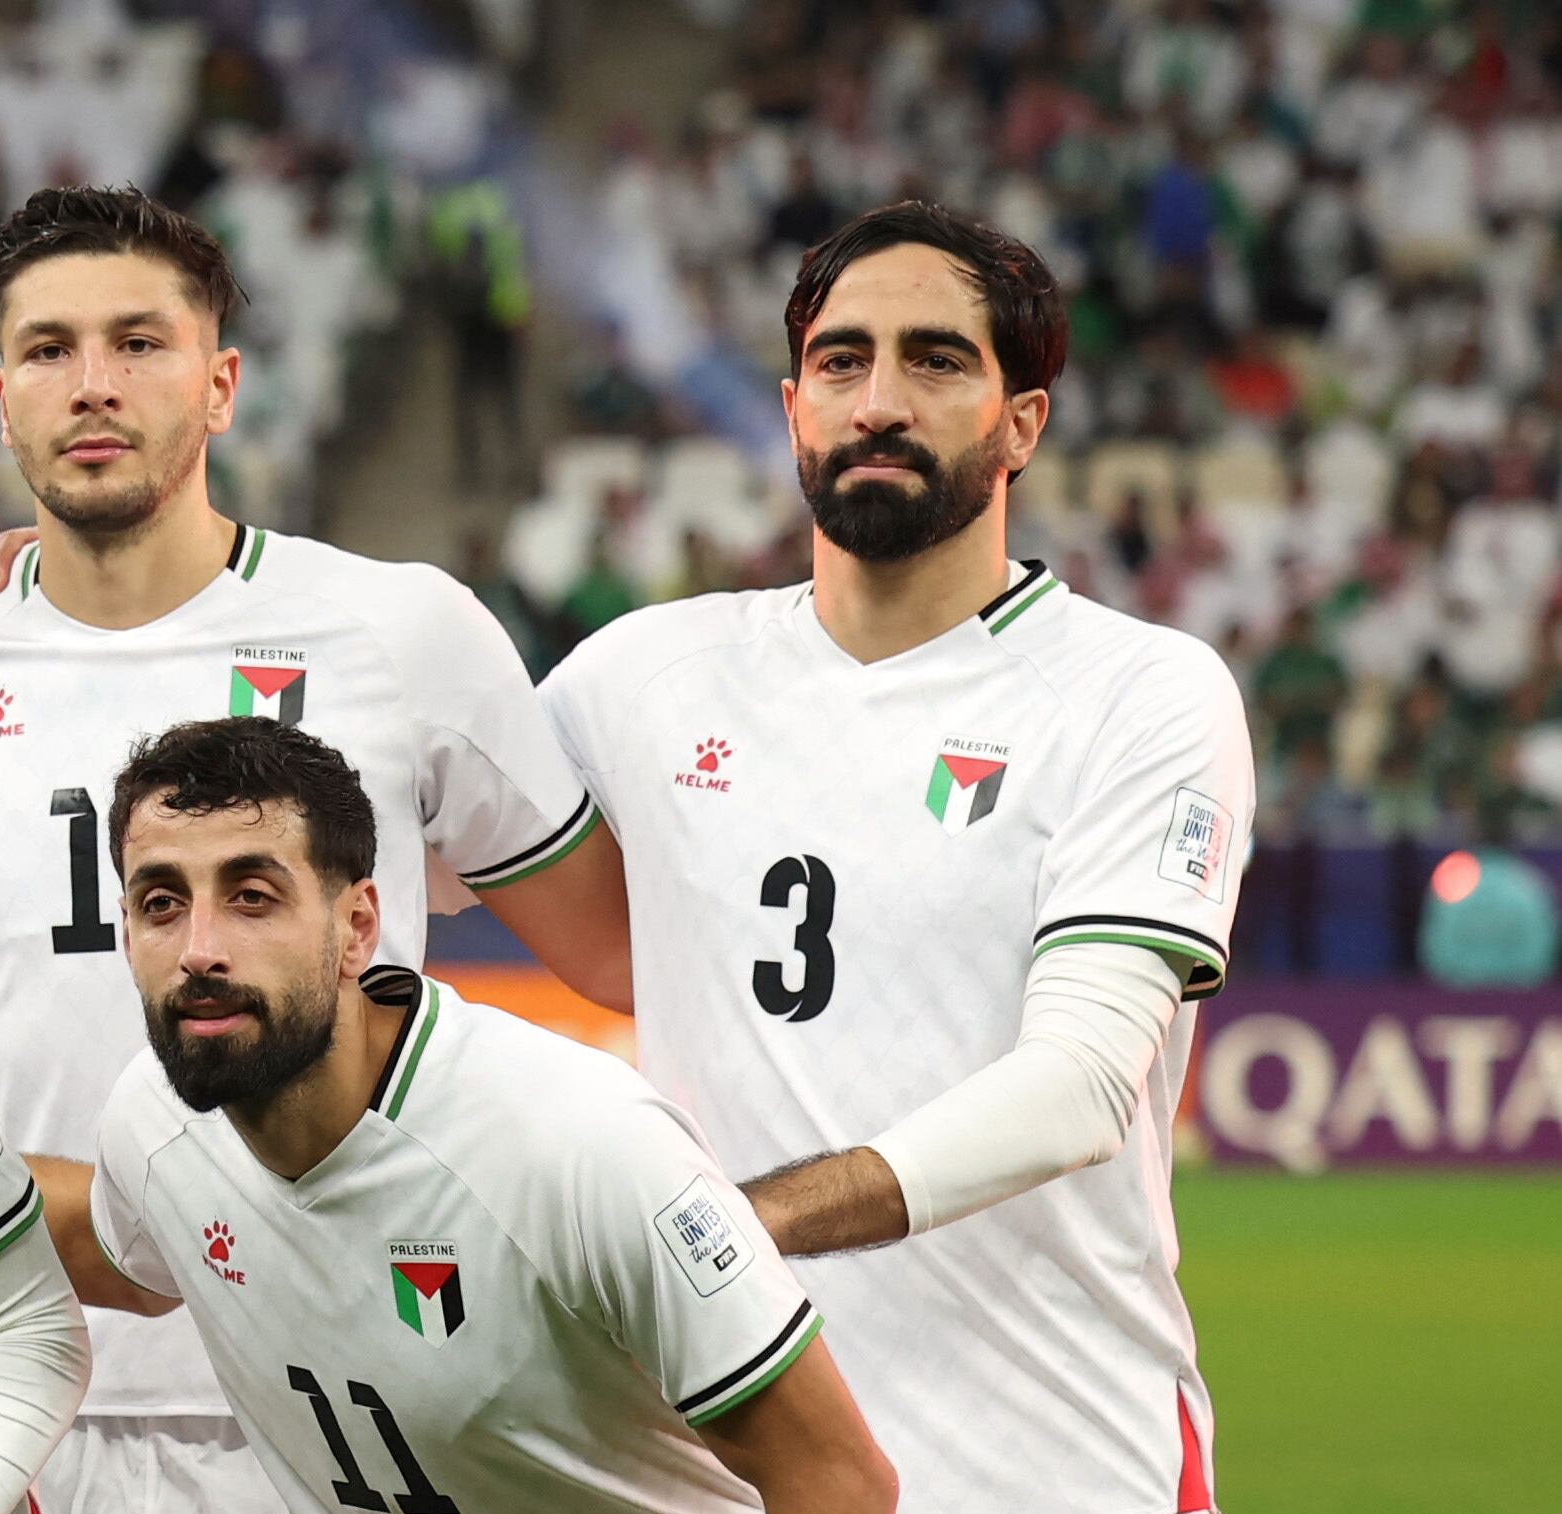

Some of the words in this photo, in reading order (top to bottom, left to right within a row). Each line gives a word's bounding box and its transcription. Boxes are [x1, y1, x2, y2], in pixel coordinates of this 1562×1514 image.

[235, 648, 306, 662] PALESTINE
[943, 738, 1011, 756] PALESTINE
[674, 773, 732, 792] KELME
[752, 854, 836, 1023] 3
[680, 1205, 721, 1246] UNITES
[390, 1245, 455, 1256] PALESTINE
[689, 1244, 712, 1263] the
